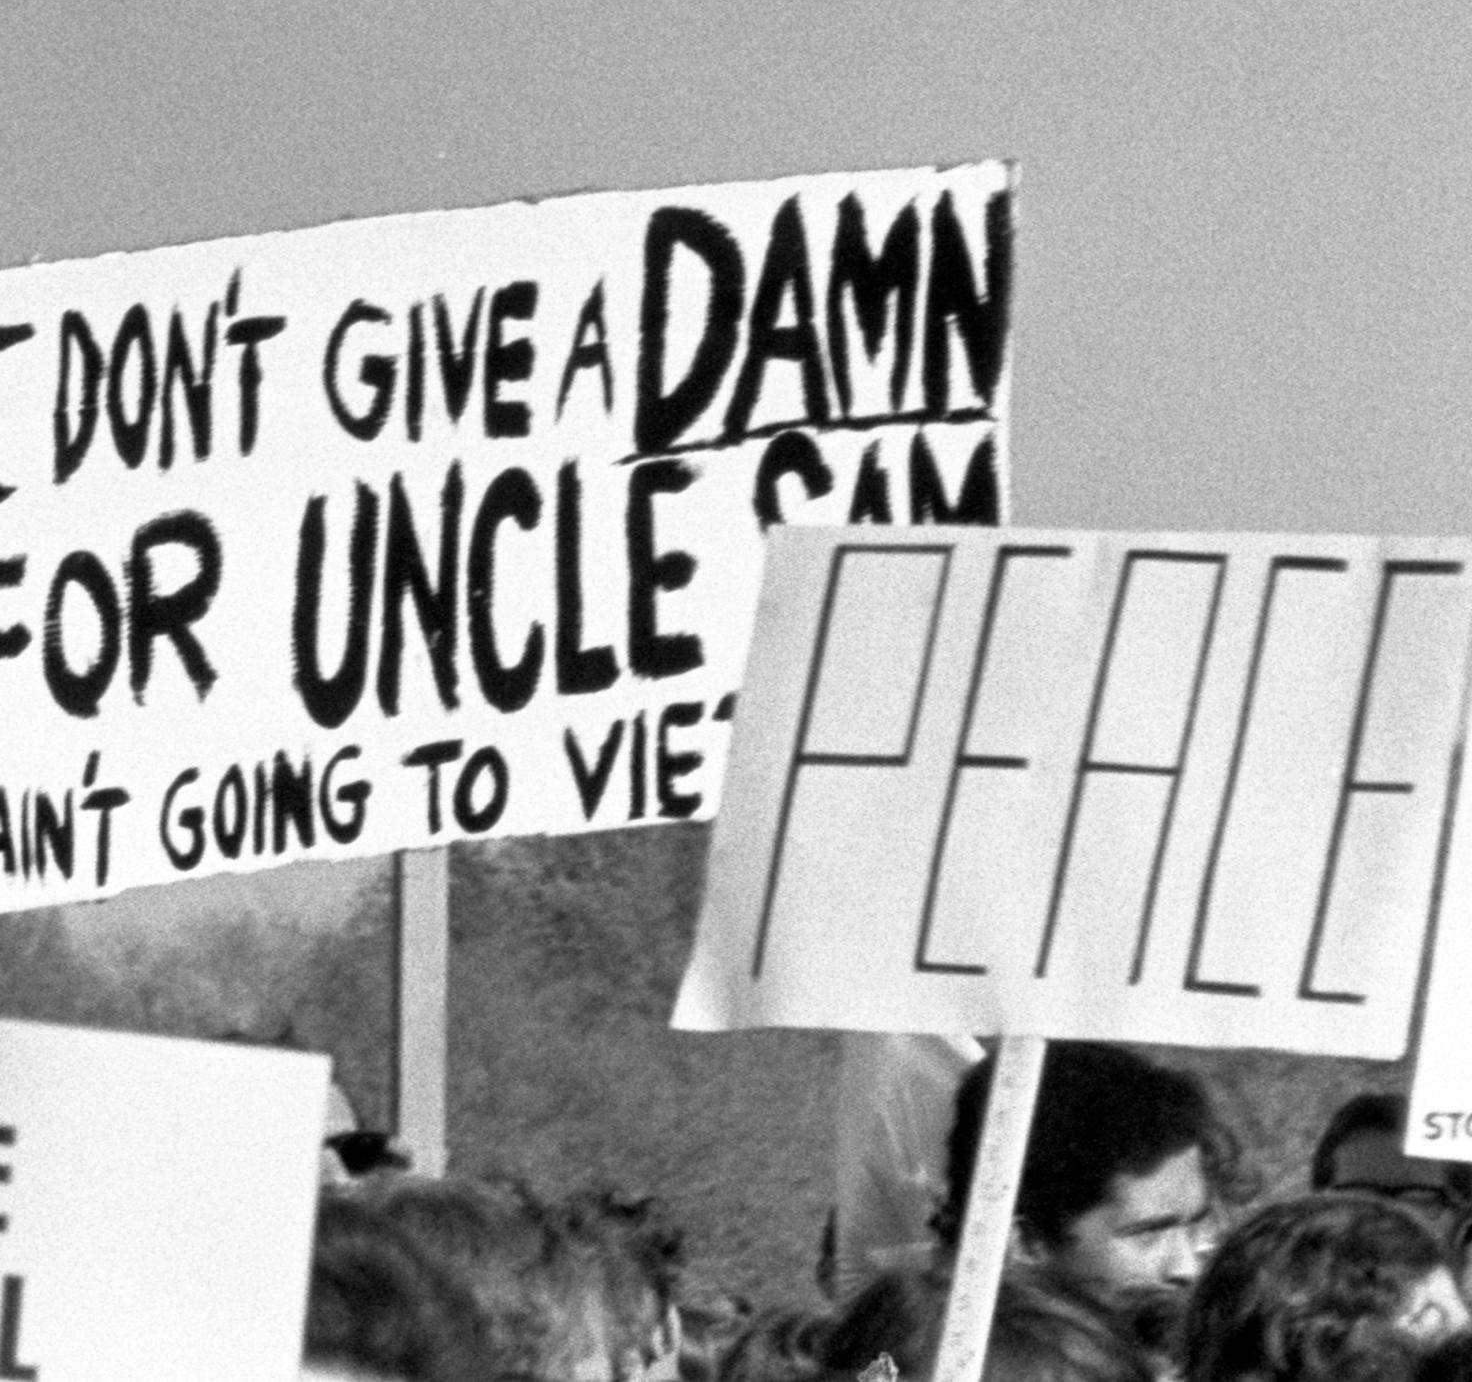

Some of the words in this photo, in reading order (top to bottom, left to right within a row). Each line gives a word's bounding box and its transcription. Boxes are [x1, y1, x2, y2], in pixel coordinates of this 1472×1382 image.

[52, 264, 287, 487] DON'T
[321, 278, 540, 444] GIVE
[556, 275, 614, 426] A
[634, 188, 1016, 454] DAMN
[291, 456, 705, 730] UNCLE
[159, 742, 373, 872] GOING
[401, 738, 510, 834] TO
[563, 690, 737, 822] VIE
[750, 541, 1466, 1006] PEACE
